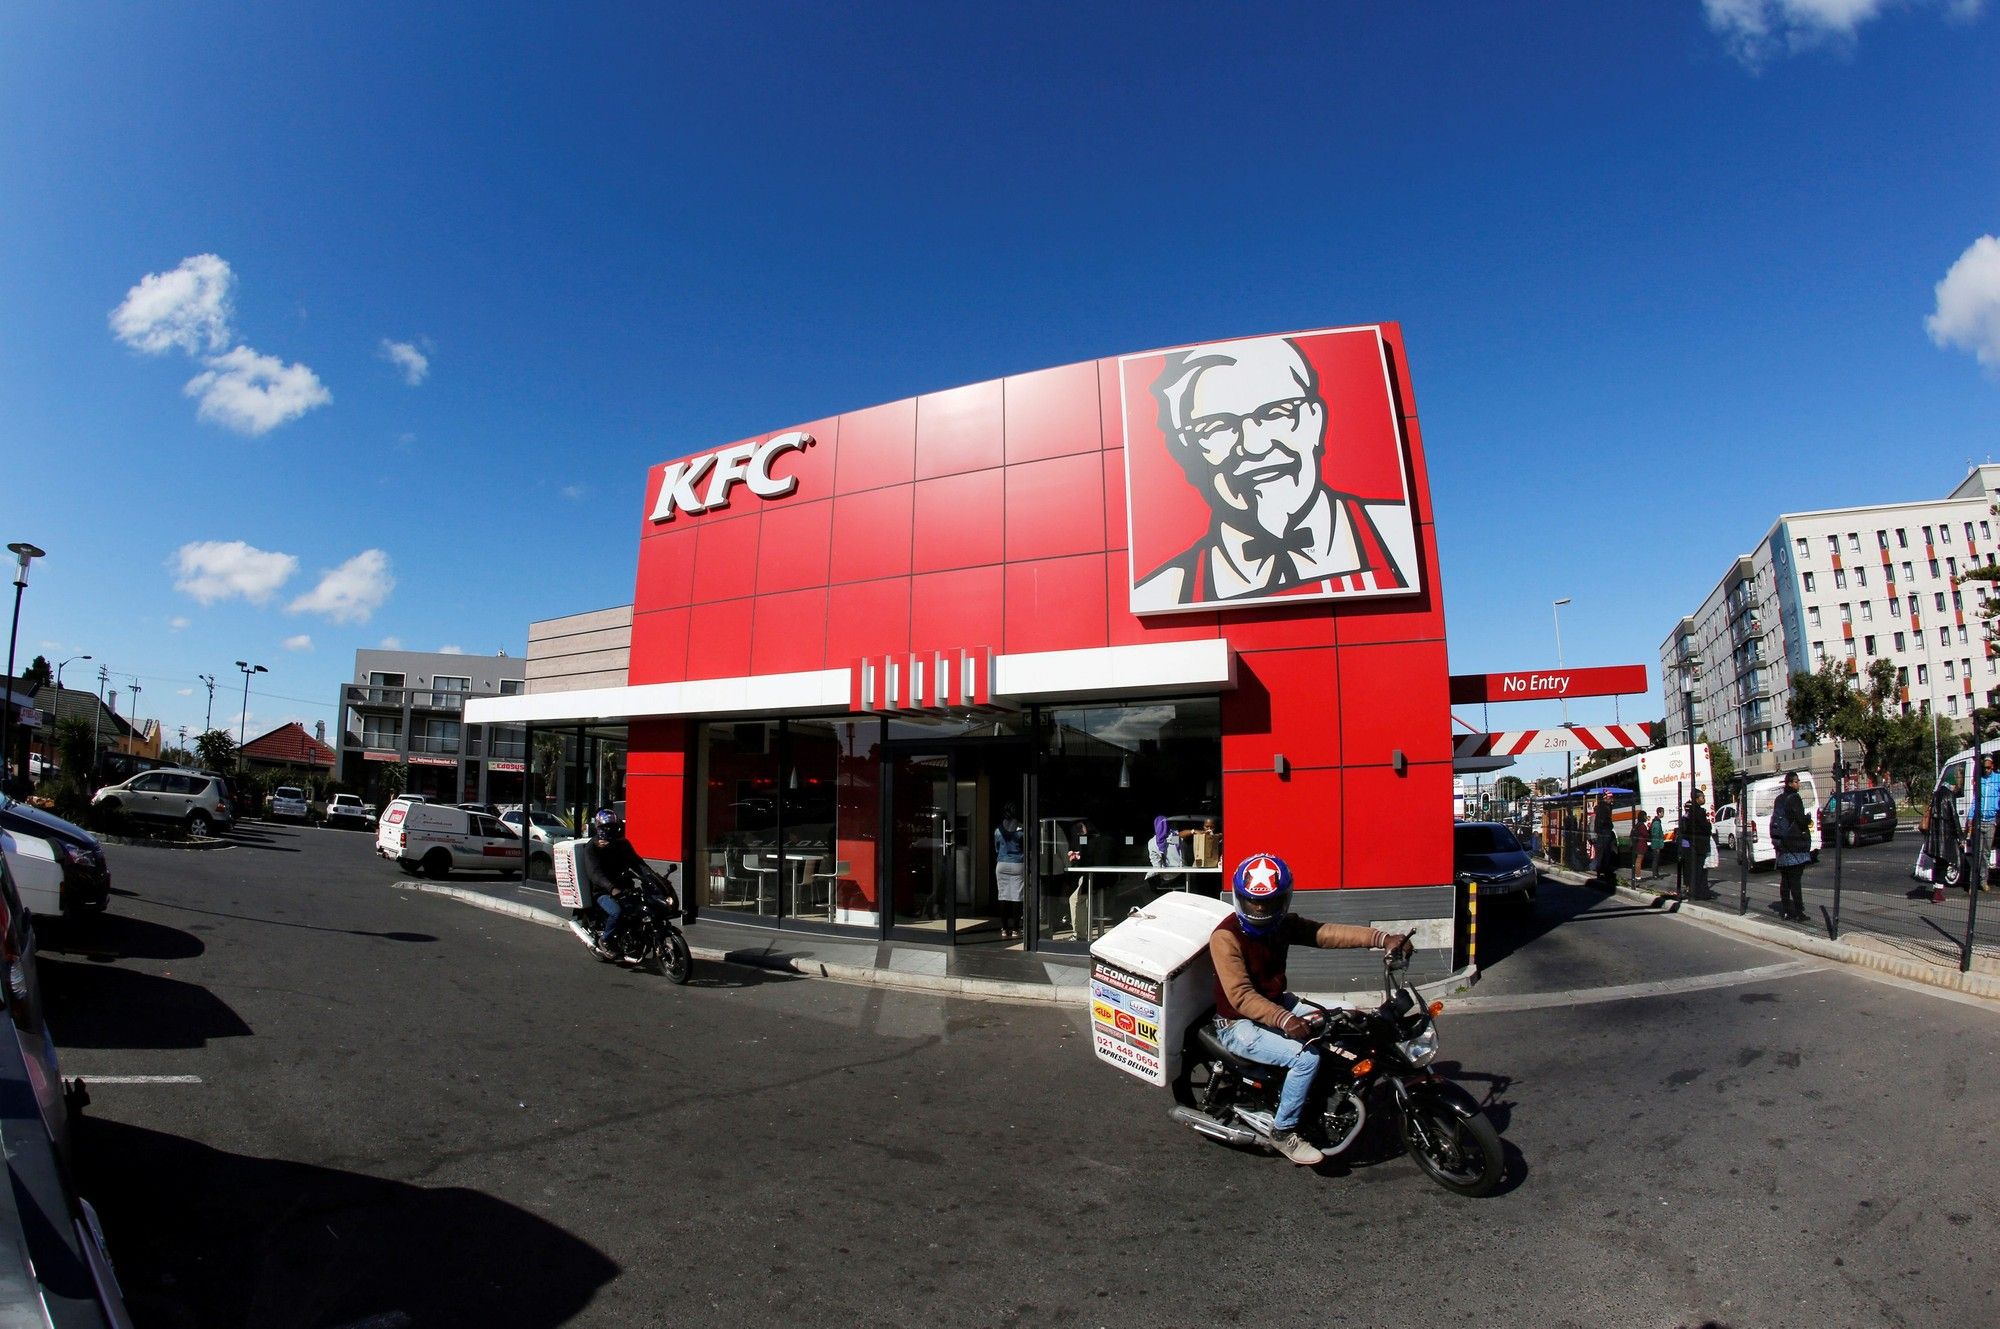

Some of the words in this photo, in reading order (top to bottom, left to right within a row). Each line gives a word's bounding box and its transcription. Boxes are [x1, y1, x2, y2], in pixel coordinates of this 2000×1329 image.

[649, 431, 806, 521] KFC
[1503, 676, 1527, 692] No
[1530, 675, 1570, 693] Entry
[1544, 737, 1568, 749] 2.3m
[1652, 773, 1679, 785] Golden
[1680, 771, 1702, 780] Arrw
[1095, 963, 1158, 995] ECONOMIC
[1097, 1035, 1113, 1048] 021
[1116, 1045, 1133, 1058] 448
[1136, 1052, 1159, 1069] 0694
[1098, 1046, 1127, 1064] EXPRESS
[1127, 1059, 1159, 1078] DELIVERY
